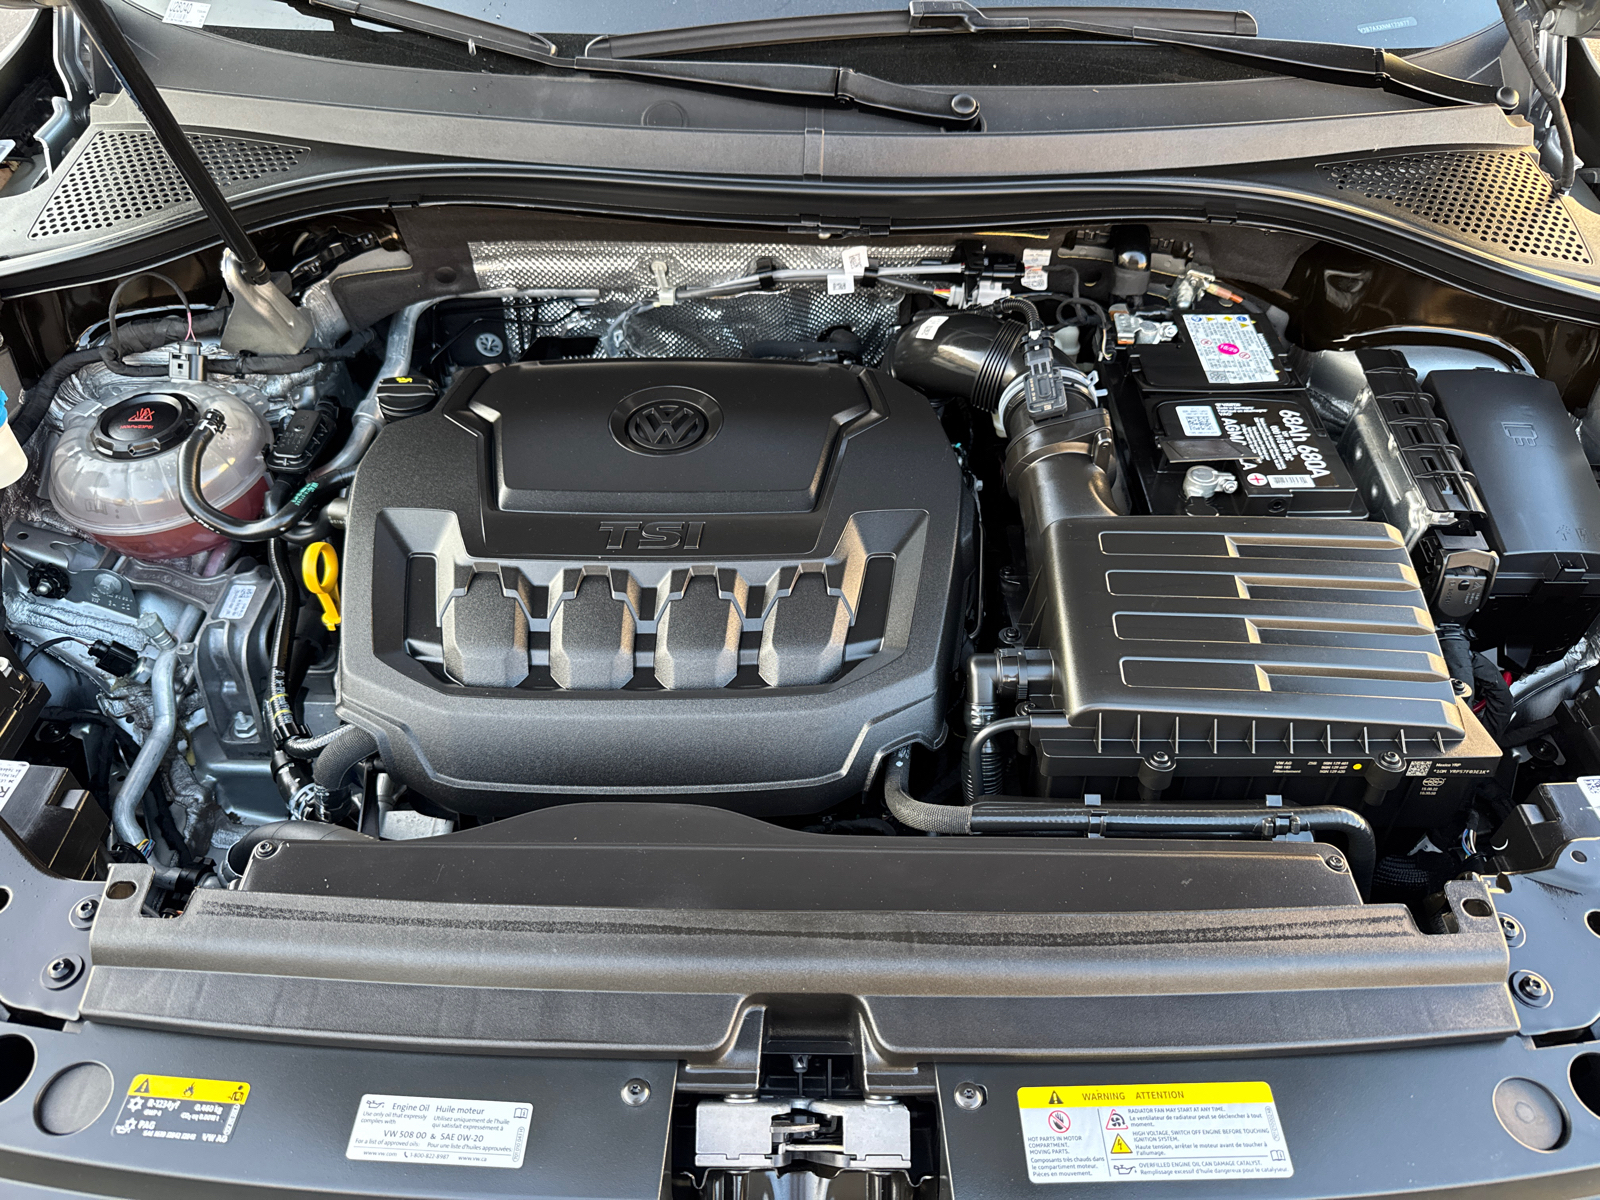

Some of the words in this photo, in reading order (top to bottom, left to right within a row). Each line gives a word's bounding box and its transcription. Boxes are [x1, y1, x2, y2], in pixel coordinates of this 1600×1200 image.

[632, 403, 703, 447] VW
[1279, 410, 1311, 442] 68Ah
[1296, 445, 1331, 478] 680A
[599, 521, 706, 550] TSI
[1082, 1092, 1125, 1101] WARNING
[1136, 1091, 1184, 1100] ATTENTION
[146, 1098, 181, 1111] R-1234yf
[392, 1103, 417, 1112] Engine
[138, 1120, 156, 1130] PAG
[457, 1134, 484, 1142] 0W-20
